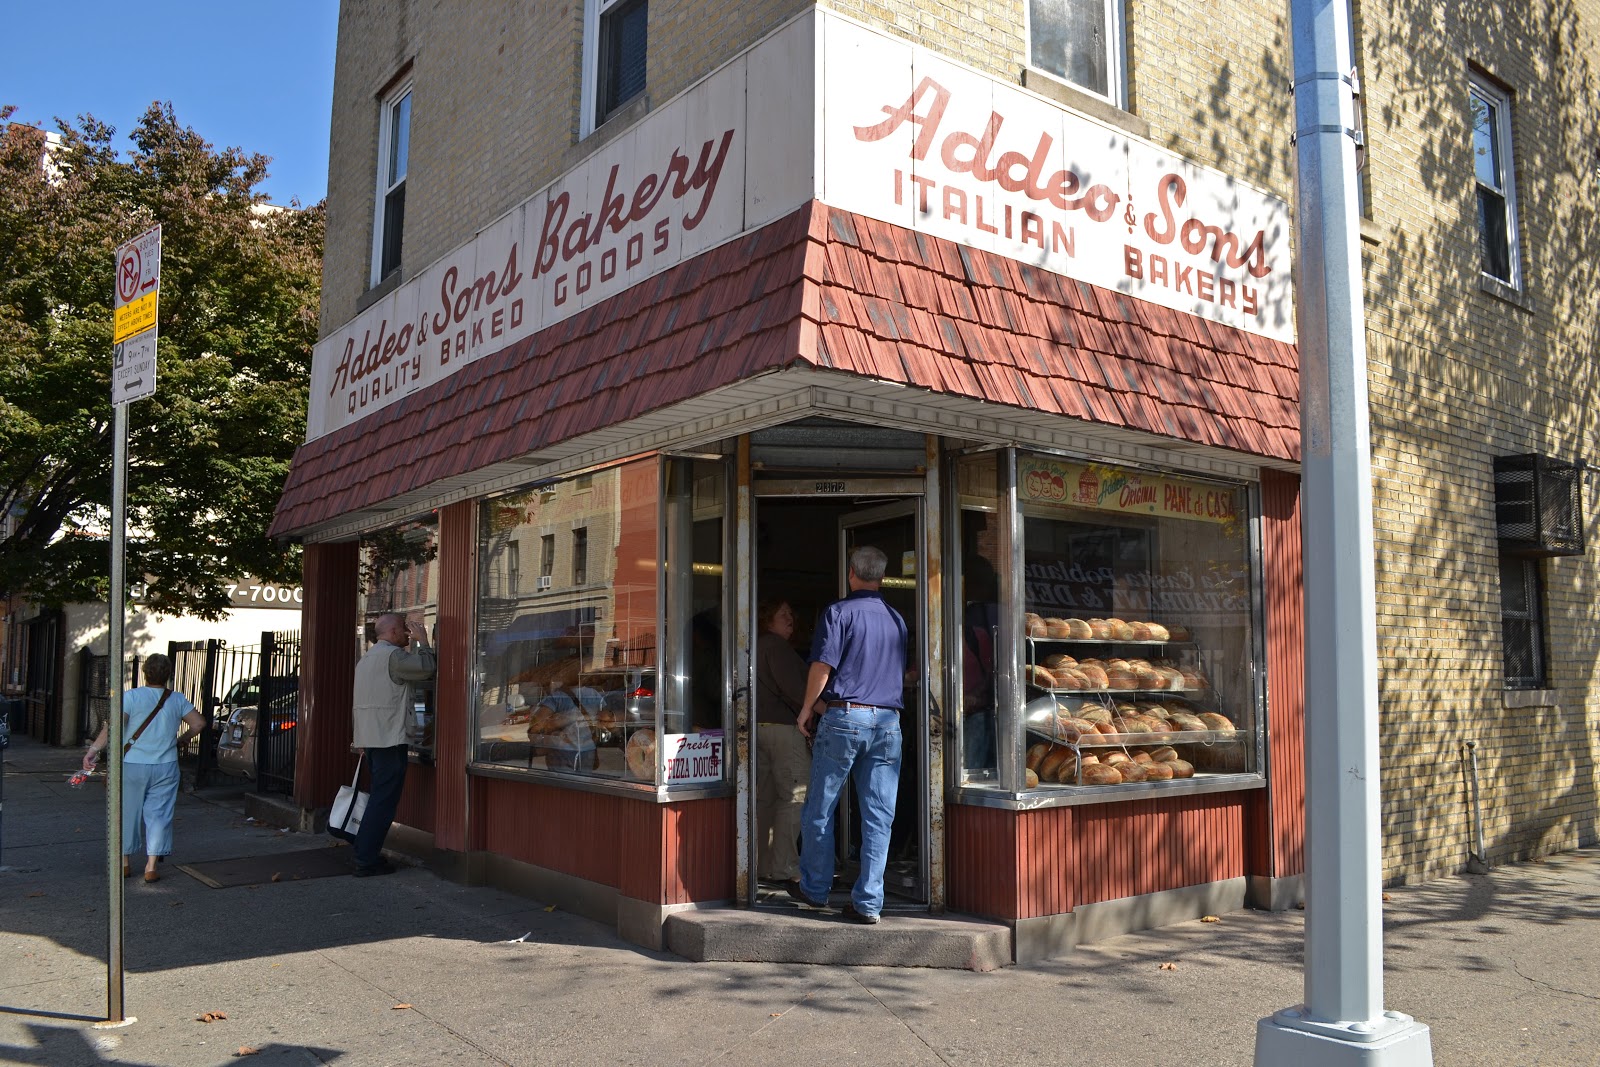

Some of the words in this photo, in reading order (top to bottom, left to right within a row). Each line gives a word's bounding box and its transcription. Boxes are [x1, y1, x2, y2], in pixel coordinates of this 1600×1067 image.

[853, 75, 1120, 222] Addeo
[1123, 194, 1137, 235] &
[1144, 173, 1272, 279] Sons
[893, 168, 1076, 259] ITALIAN
[1124, 244, 1258, 316] BAKERY
[330, 320, 414, 398] Addeo
[417, 311, 428, 343] &
[433, 242, 522, 335] Sons
[532, 129, 735, 279] Bakery
[117, 321, 131, 333] EFFECT
[130, 315, 142, 327] ABOVE
[143, 310, 153, 322] TIMES
[118, 309, 133, 322] METERS
[133, 306, 141, 316] ARE
[140, 302, 148, 312] NOT
[148, 301, 153, 309] IN
[348, 354, 421, 414] QUALITY
[440, 299, 524, 366] BAKED
[554, 217, 670, 307] GOODS
[116, 343, 123, 367] 2
[117, 366, 133, 381] EXCEPT
[134, 360, 151, 375] SUNDAY
[816, 481, 846, 493] 2372
[1163, 483, 1193, 514] PANE
[1194, 495, 1204, 516] di
[1206, 490, 1236, 518] CASA
[676, 737, 710, 753] Fresh
[667, 757, 690, 780] PIZZA
[693, 755, 719, 778] DOUGH
